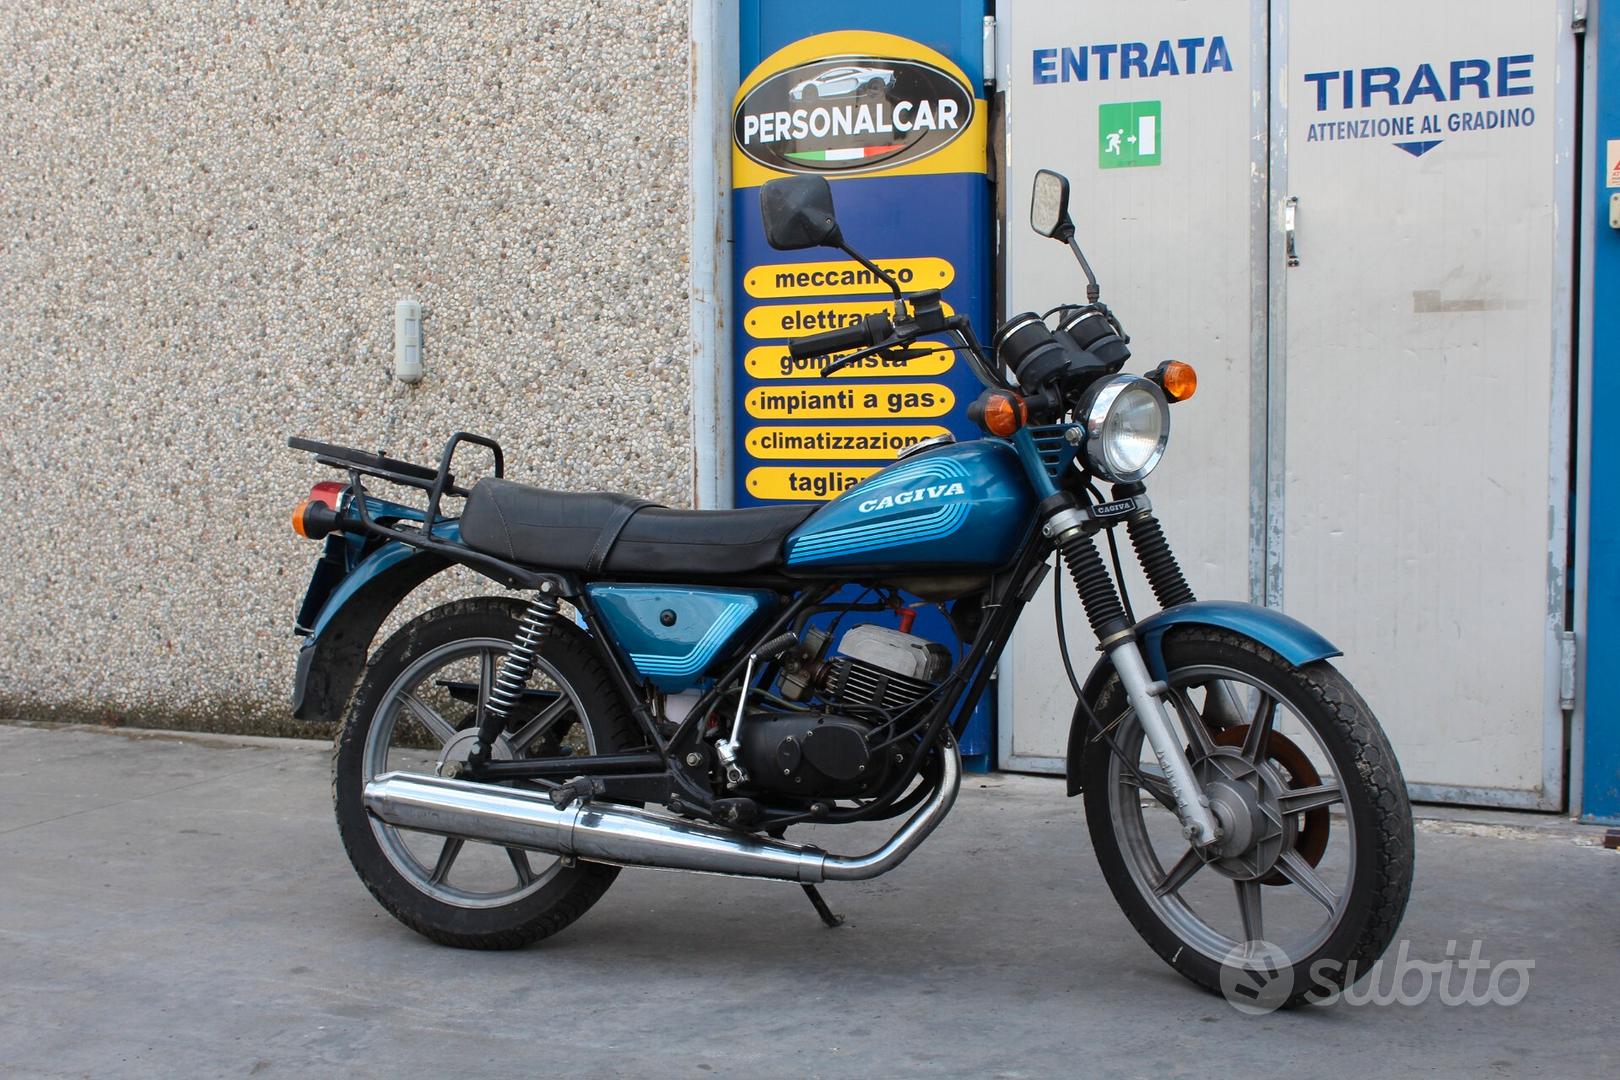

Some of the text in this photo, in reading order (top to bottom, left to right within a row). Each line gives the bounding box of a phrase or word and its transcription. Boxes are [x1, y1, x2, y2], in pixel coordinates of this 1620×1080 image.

[1033, 35, 1233, 85] ENTRATA
[1304, 54, 1534, 111] TIRARE
[743, 99, 958, 145] PERSONALCAR
[1307, 107, 1535, 142] ATTENZIONE AL GRADINO
[781, 308, 891, 330] elettra
[760, 390, 935, 414] impianti a gas
[789, 472, 866, 496] taglia
[858, 482, 965, 513] CAGIVA
[1098, 502, 1131, 514] CAGIVA
